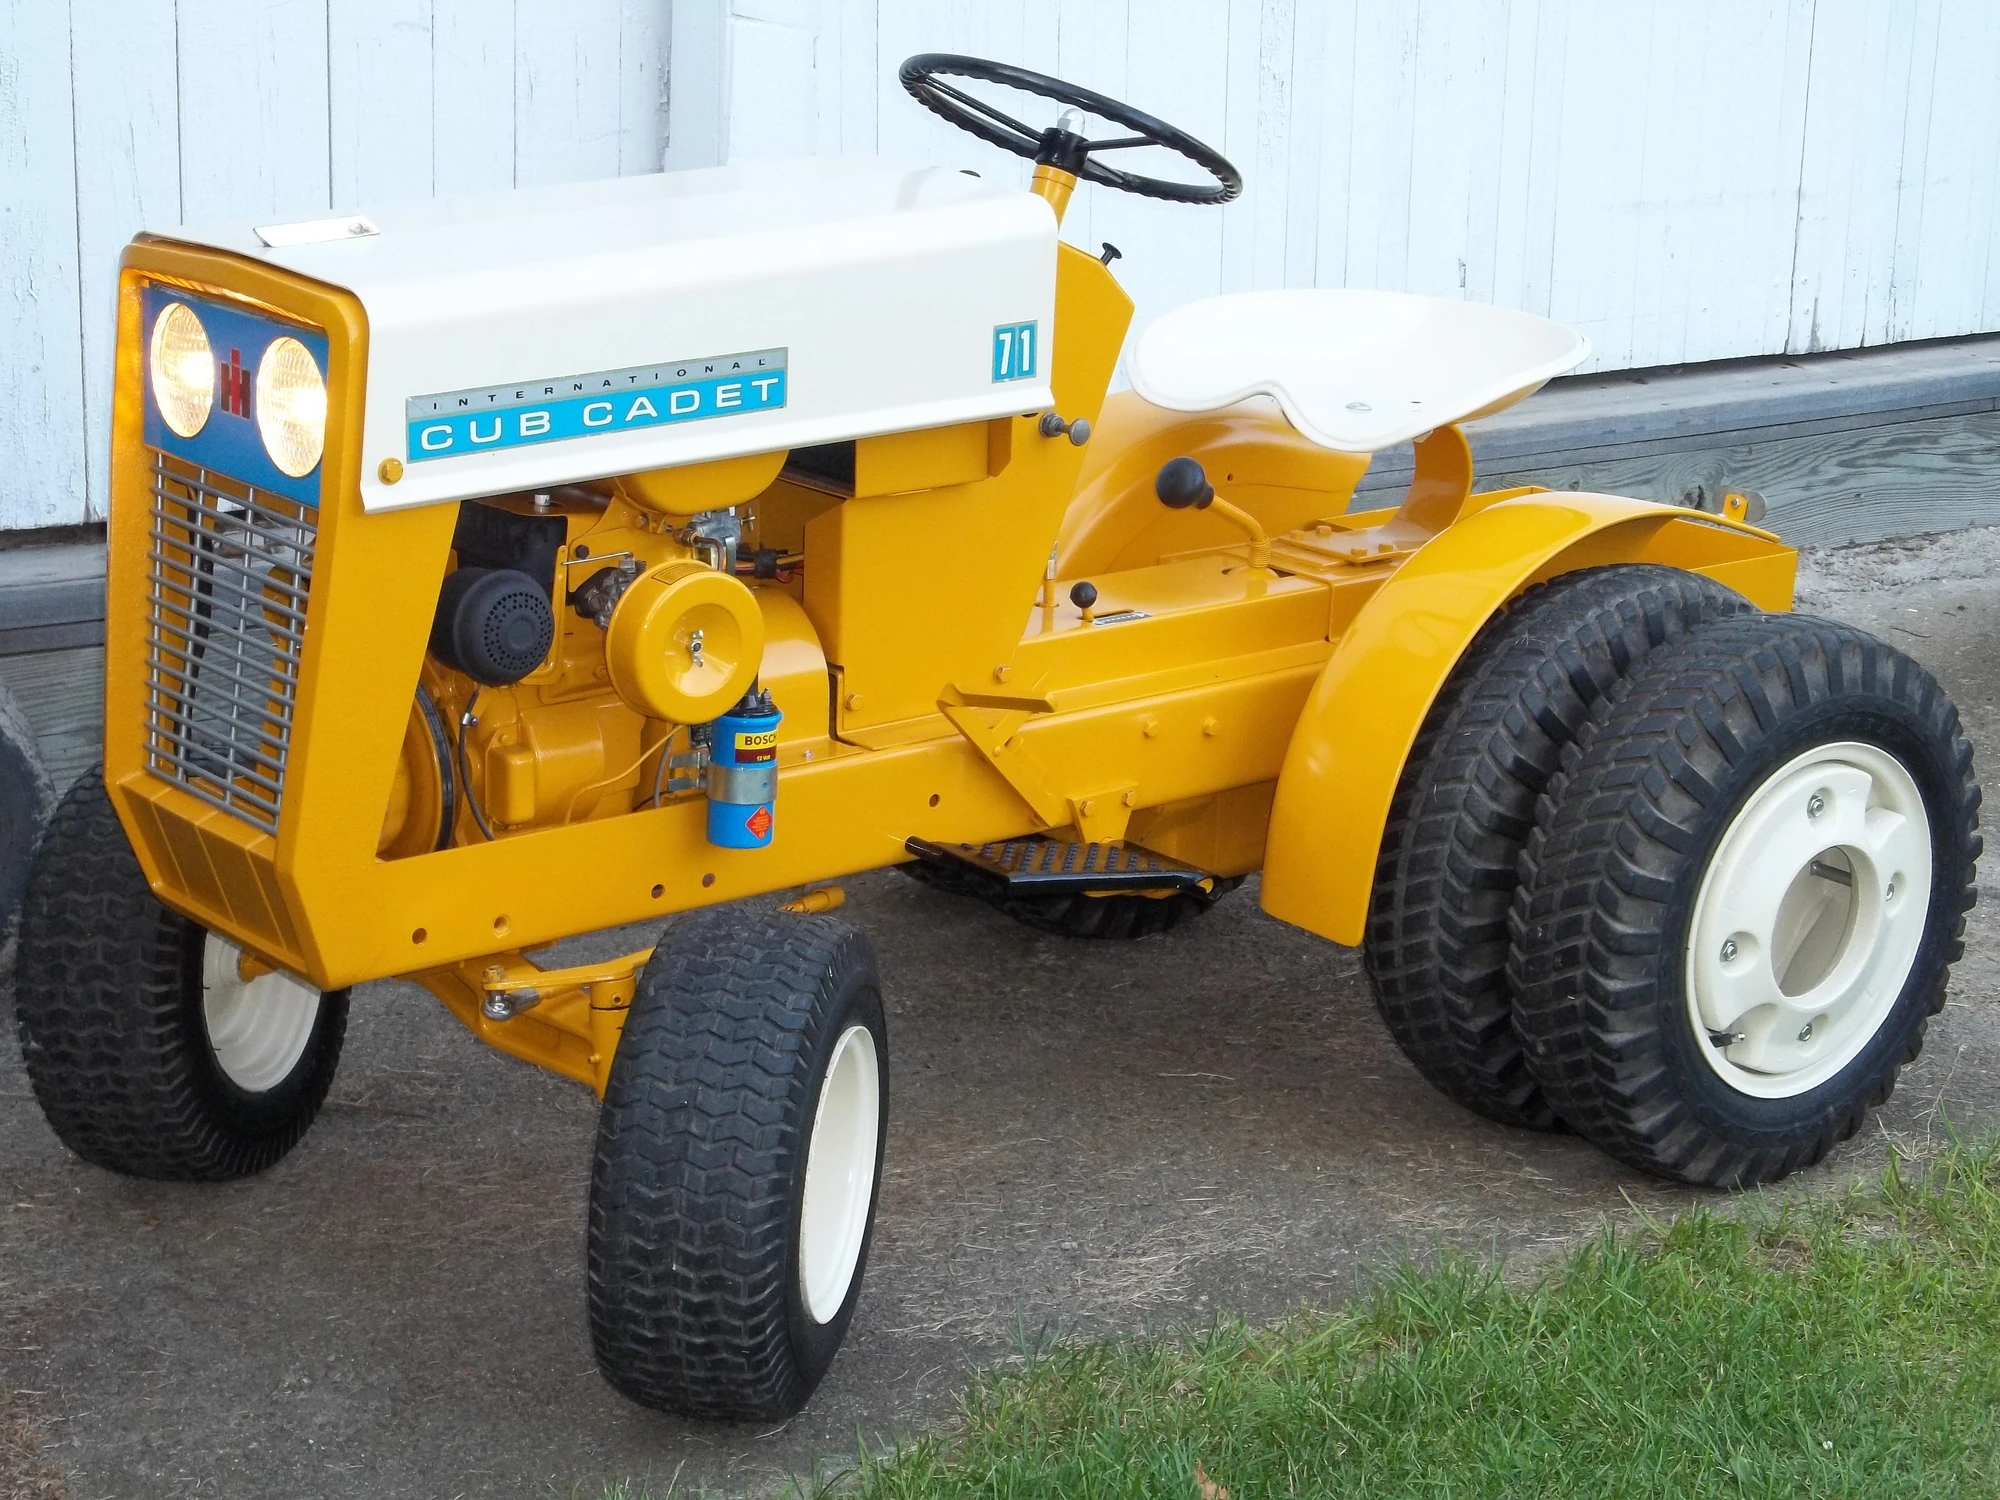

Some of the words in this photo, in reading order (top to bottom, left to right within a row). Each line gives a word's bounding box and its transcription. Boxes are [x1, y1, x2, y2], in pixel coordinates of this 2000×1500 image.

[998, 329, 1031, 375] 71
[433, 358, 766, 411] INTERNATIONAL
[420, 408, 552, 452] CUB
[582, 377, 780, 428] CADET
